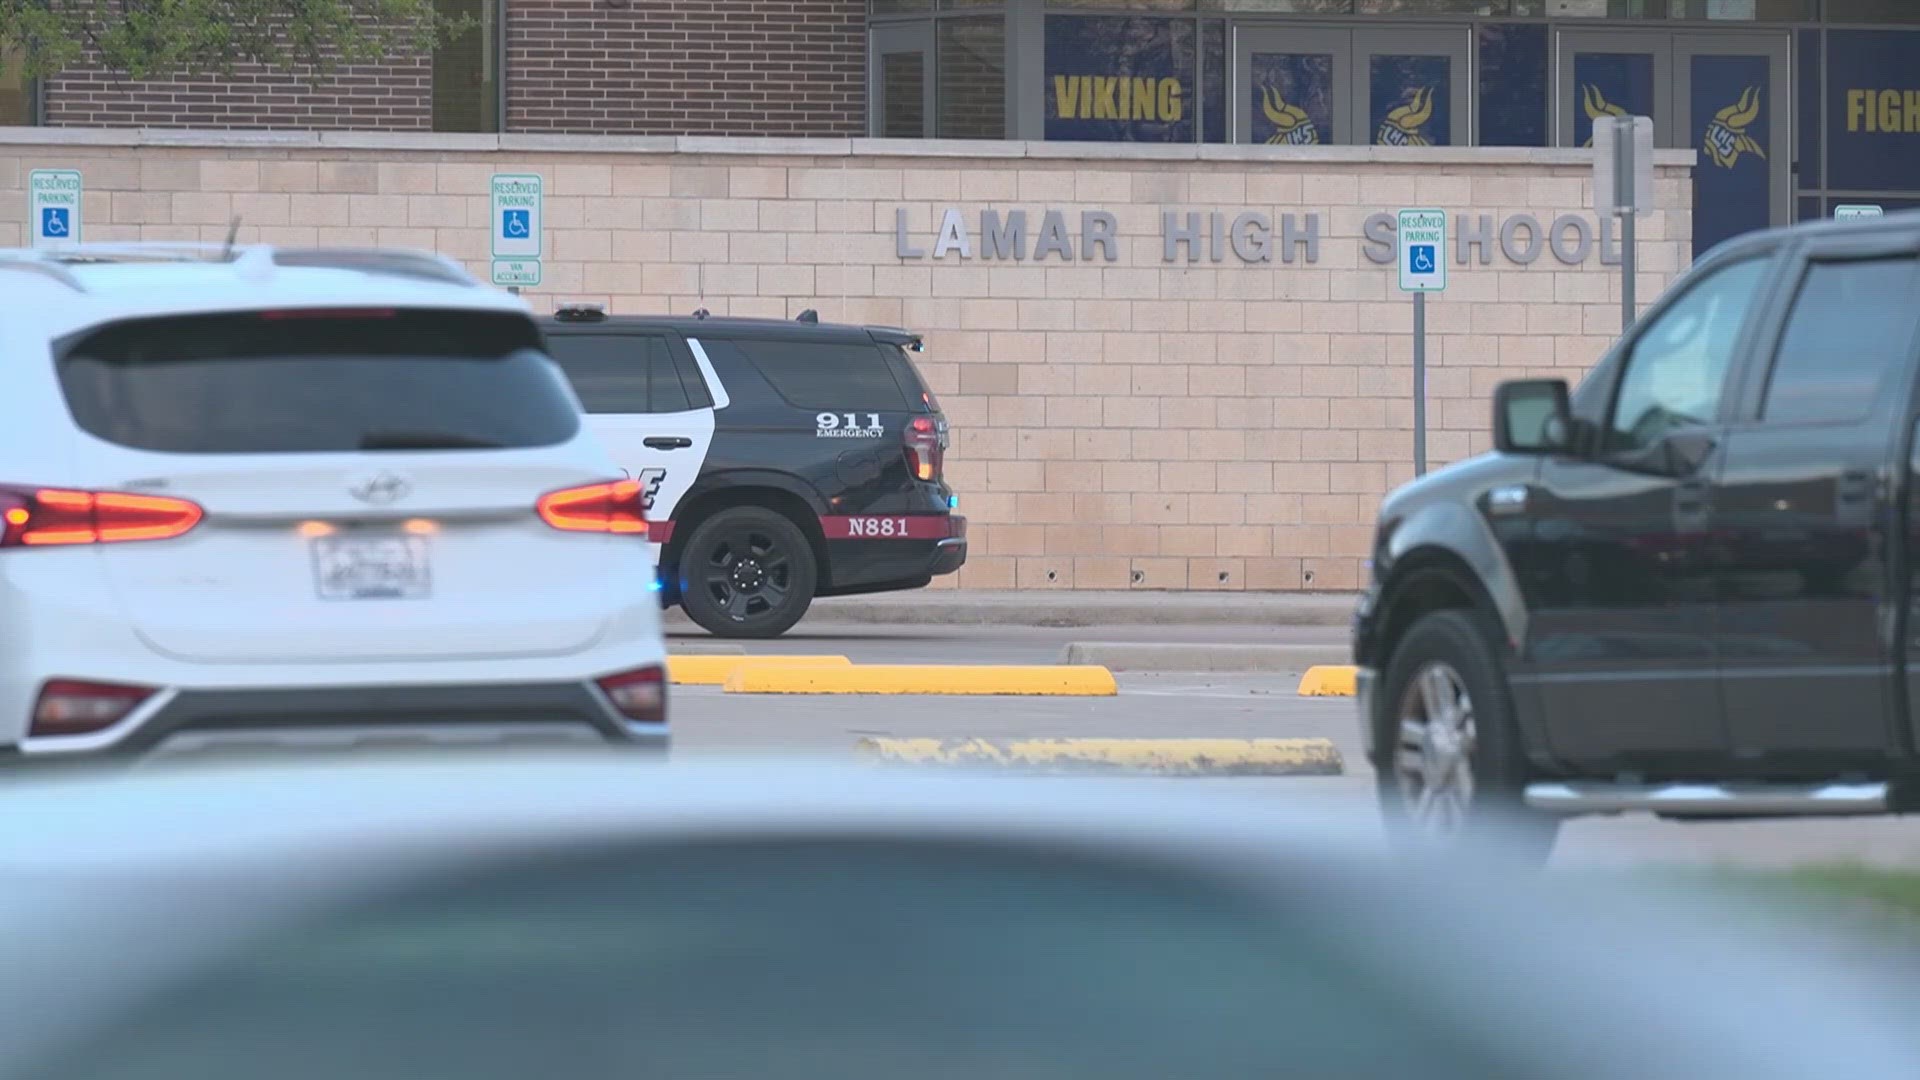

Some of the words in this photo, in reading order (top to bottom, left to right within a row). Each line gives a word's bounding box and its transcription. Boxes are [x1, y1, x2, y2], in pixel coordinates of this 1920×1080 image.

[1054, 75, 1182, 121] VIKING
[1847, 88, 1920, 133] FIGH
[34, 178, 80, 190] RESERVED
[495, 182, 538, 194] RESERVED
[38, 192, 74, 204] PARKING
[498, 195, 535, 207] PARKING
[1401, 217, 1443, 229] RESERVED
[896, 207, 1118, 261] LAMAR
[1163, 211, 1319, 263] HIGH
[1363, 212, 1622, 266] SHOOL
[1405, 231, 1440, 242] PARKING
[816, 412, 884, 429] 911
[816, 428, 884, 438] EMERGENCY
[848, 518, 908, 536] N881
